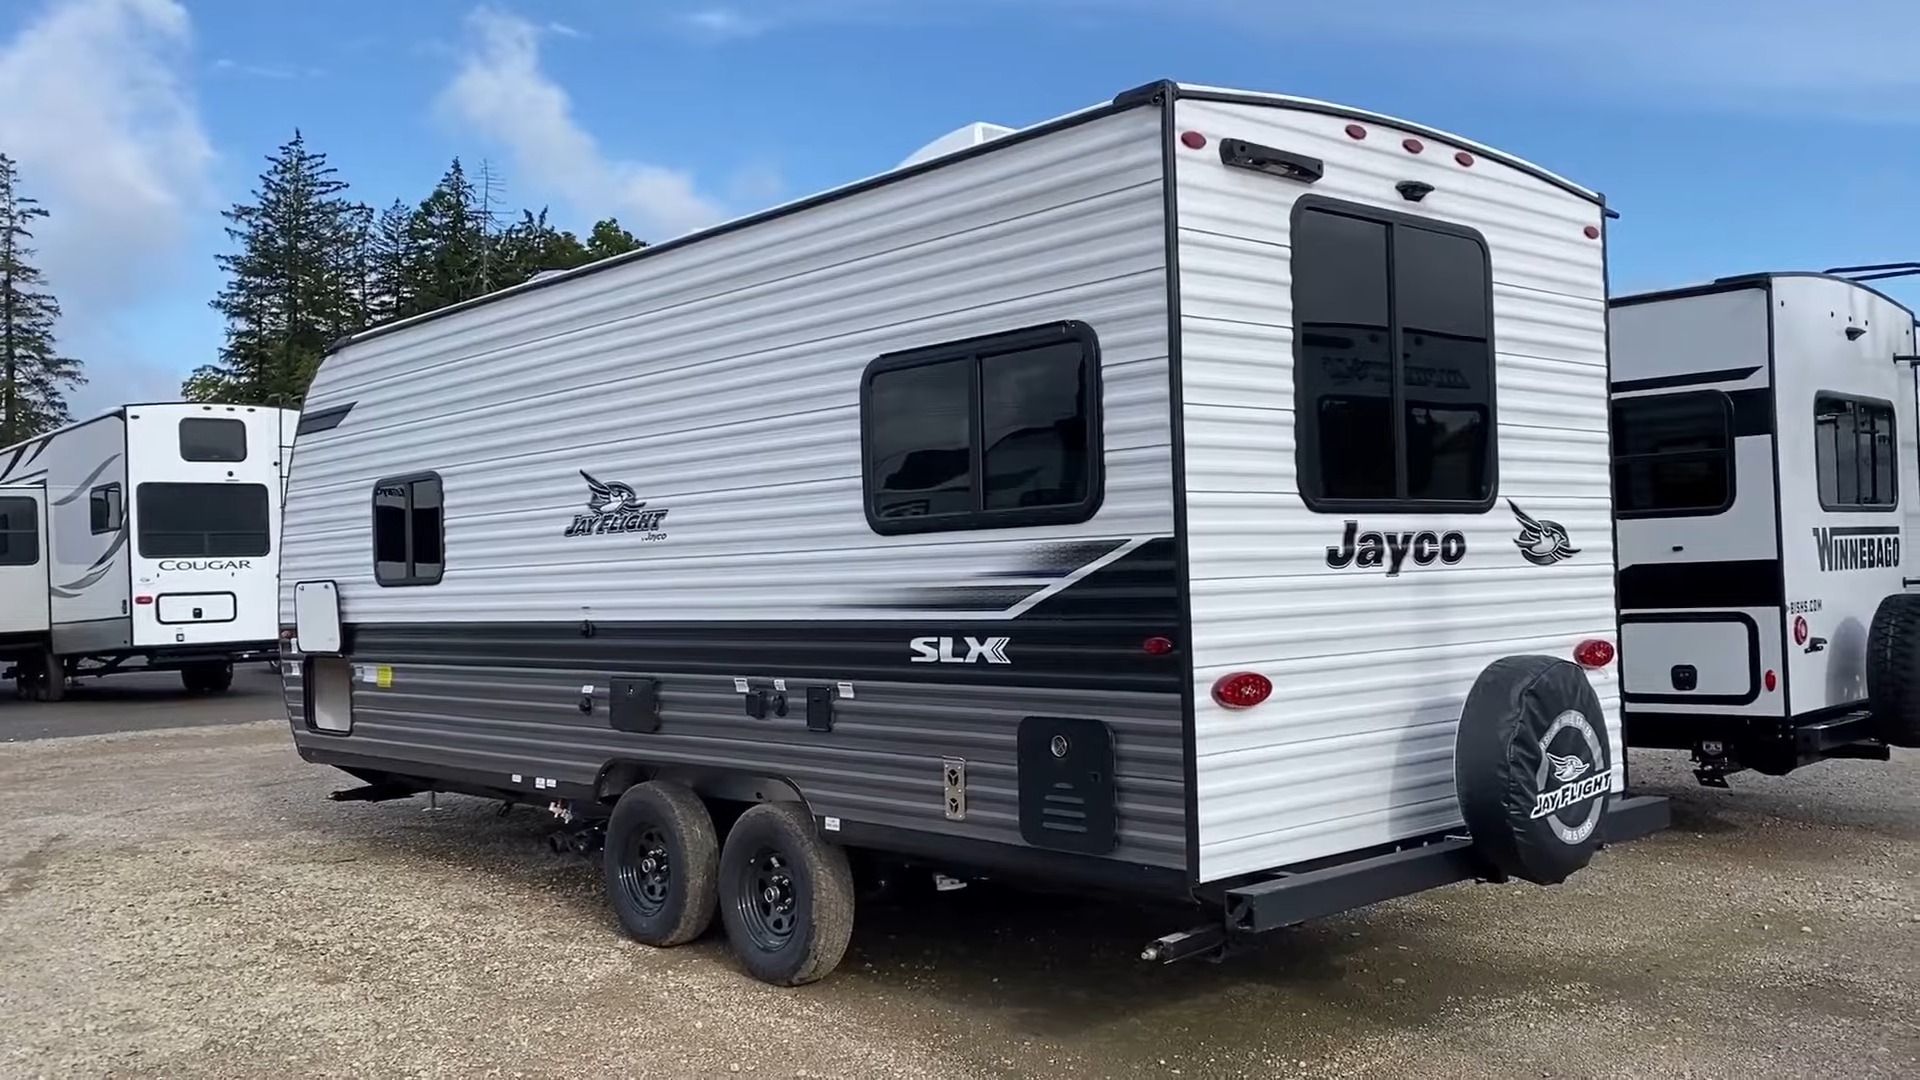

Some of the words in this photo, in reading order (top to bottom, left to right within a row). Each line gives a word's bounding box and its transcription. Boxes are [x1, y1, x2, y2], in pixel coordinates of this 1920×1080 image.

[564, 514, 599, 537] JAY
[595, 508, 669, 535] FLIGHT
[1325, 519, 1467, 577] Jayco
[1811, 526, 1900, 572] WINNEBAGO
[910, 636, 1012, 664] SLX
[1530, 792, 1561, 819] JAY
[1558, 770, 1611, 809] FLIGHT
